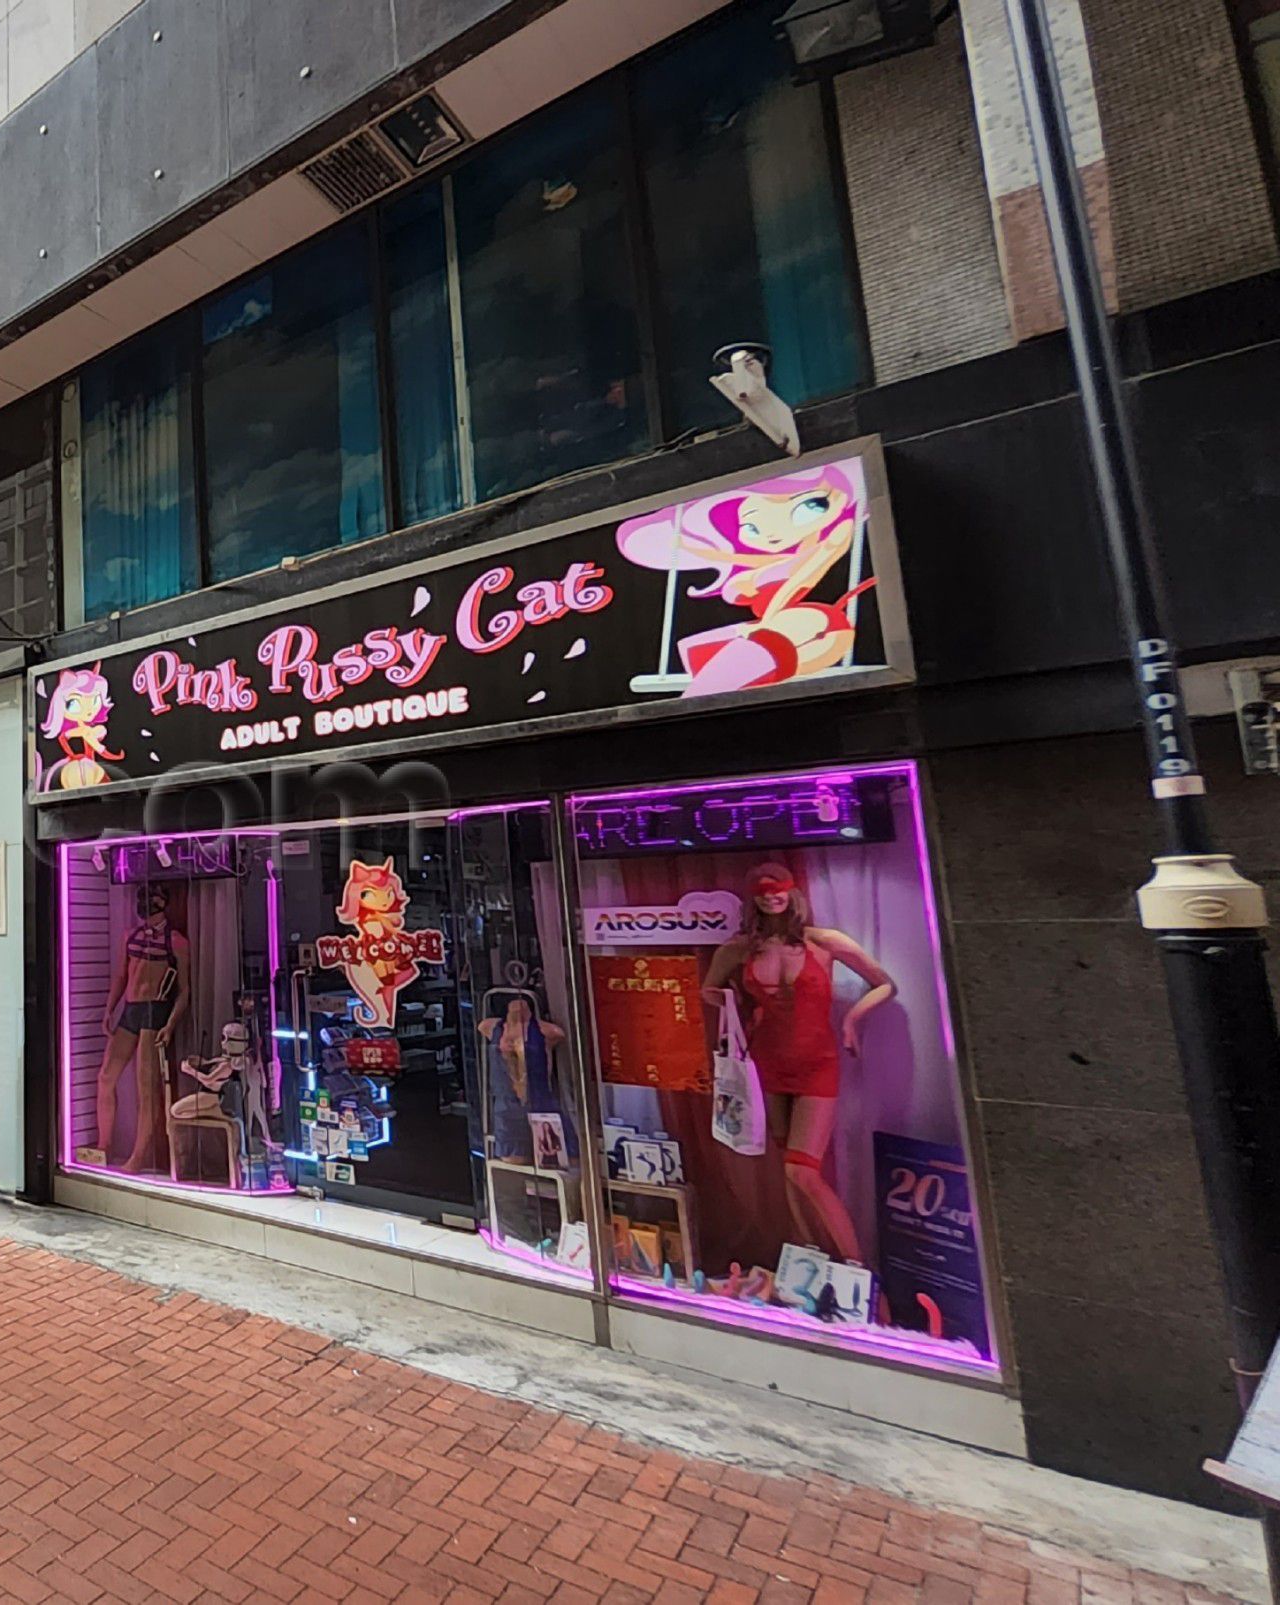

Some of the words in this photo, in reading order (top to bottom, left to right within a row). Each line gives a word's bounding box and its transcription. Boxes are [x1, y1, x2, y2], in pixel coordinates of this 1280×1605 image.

[132, 650, 258, 715] Pink
[258, 624, 447, 702] Pussy
[455, 562, 614, 653] Cat
[220, 716, 301, 750] ADULT
[314, 687, 469, 736] BOUTIQUE
[322, 938, 439, 961] WELCOME!
[886, 1168, 945, 1216] 20
